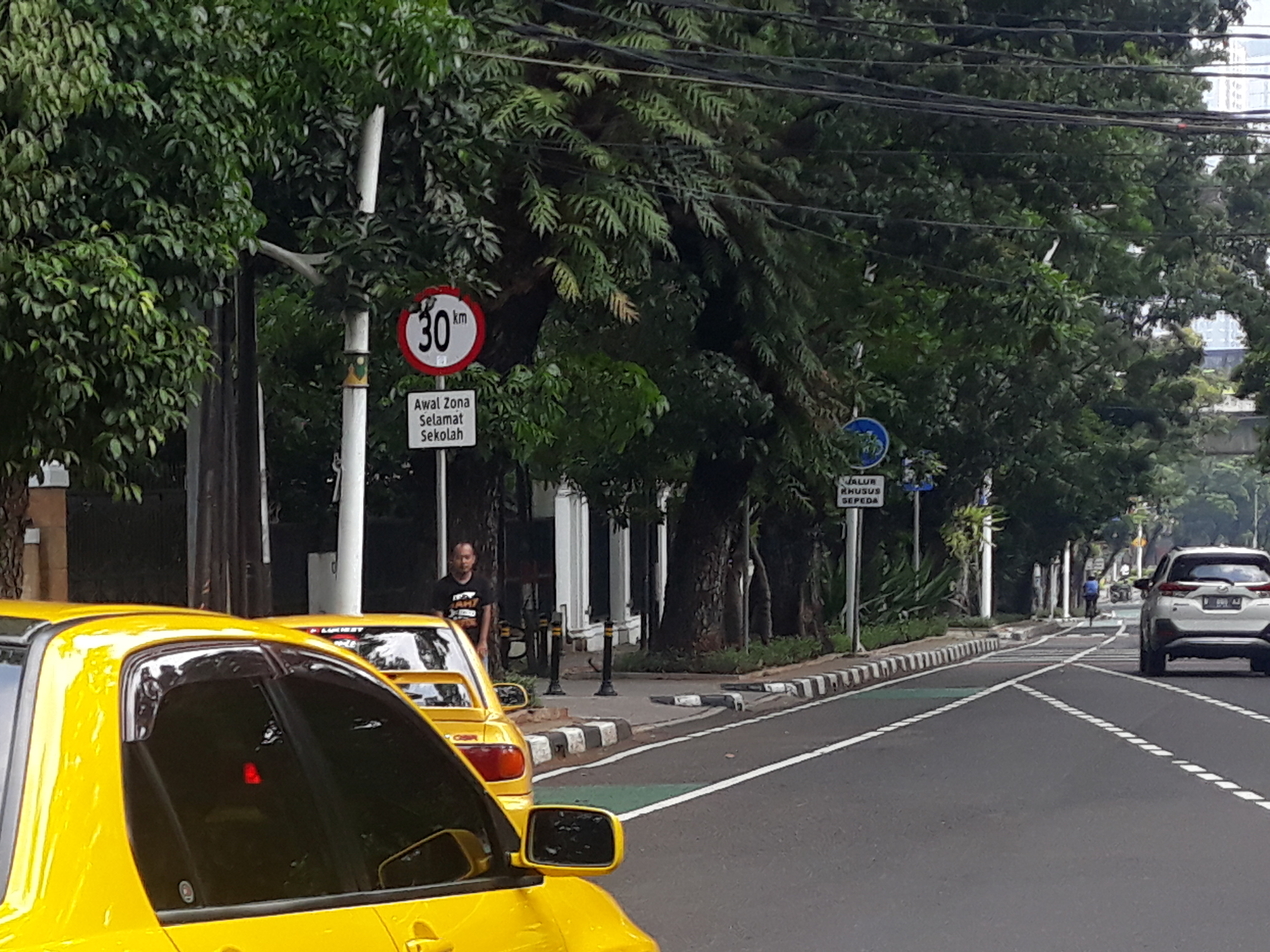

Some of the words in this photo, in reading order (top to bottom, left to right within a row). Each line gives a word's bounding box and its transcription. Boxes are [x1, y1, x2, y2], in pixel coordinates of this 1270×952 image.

[418, 310, 450, 352] 30
[453, 310, 467, 324] km
[414, 397, 440, 411] Awal
[444, 396, 470, 409] Zona
[419, 412, 464, 426] Selamat
[421, 428, 464, 442] Sekolah
